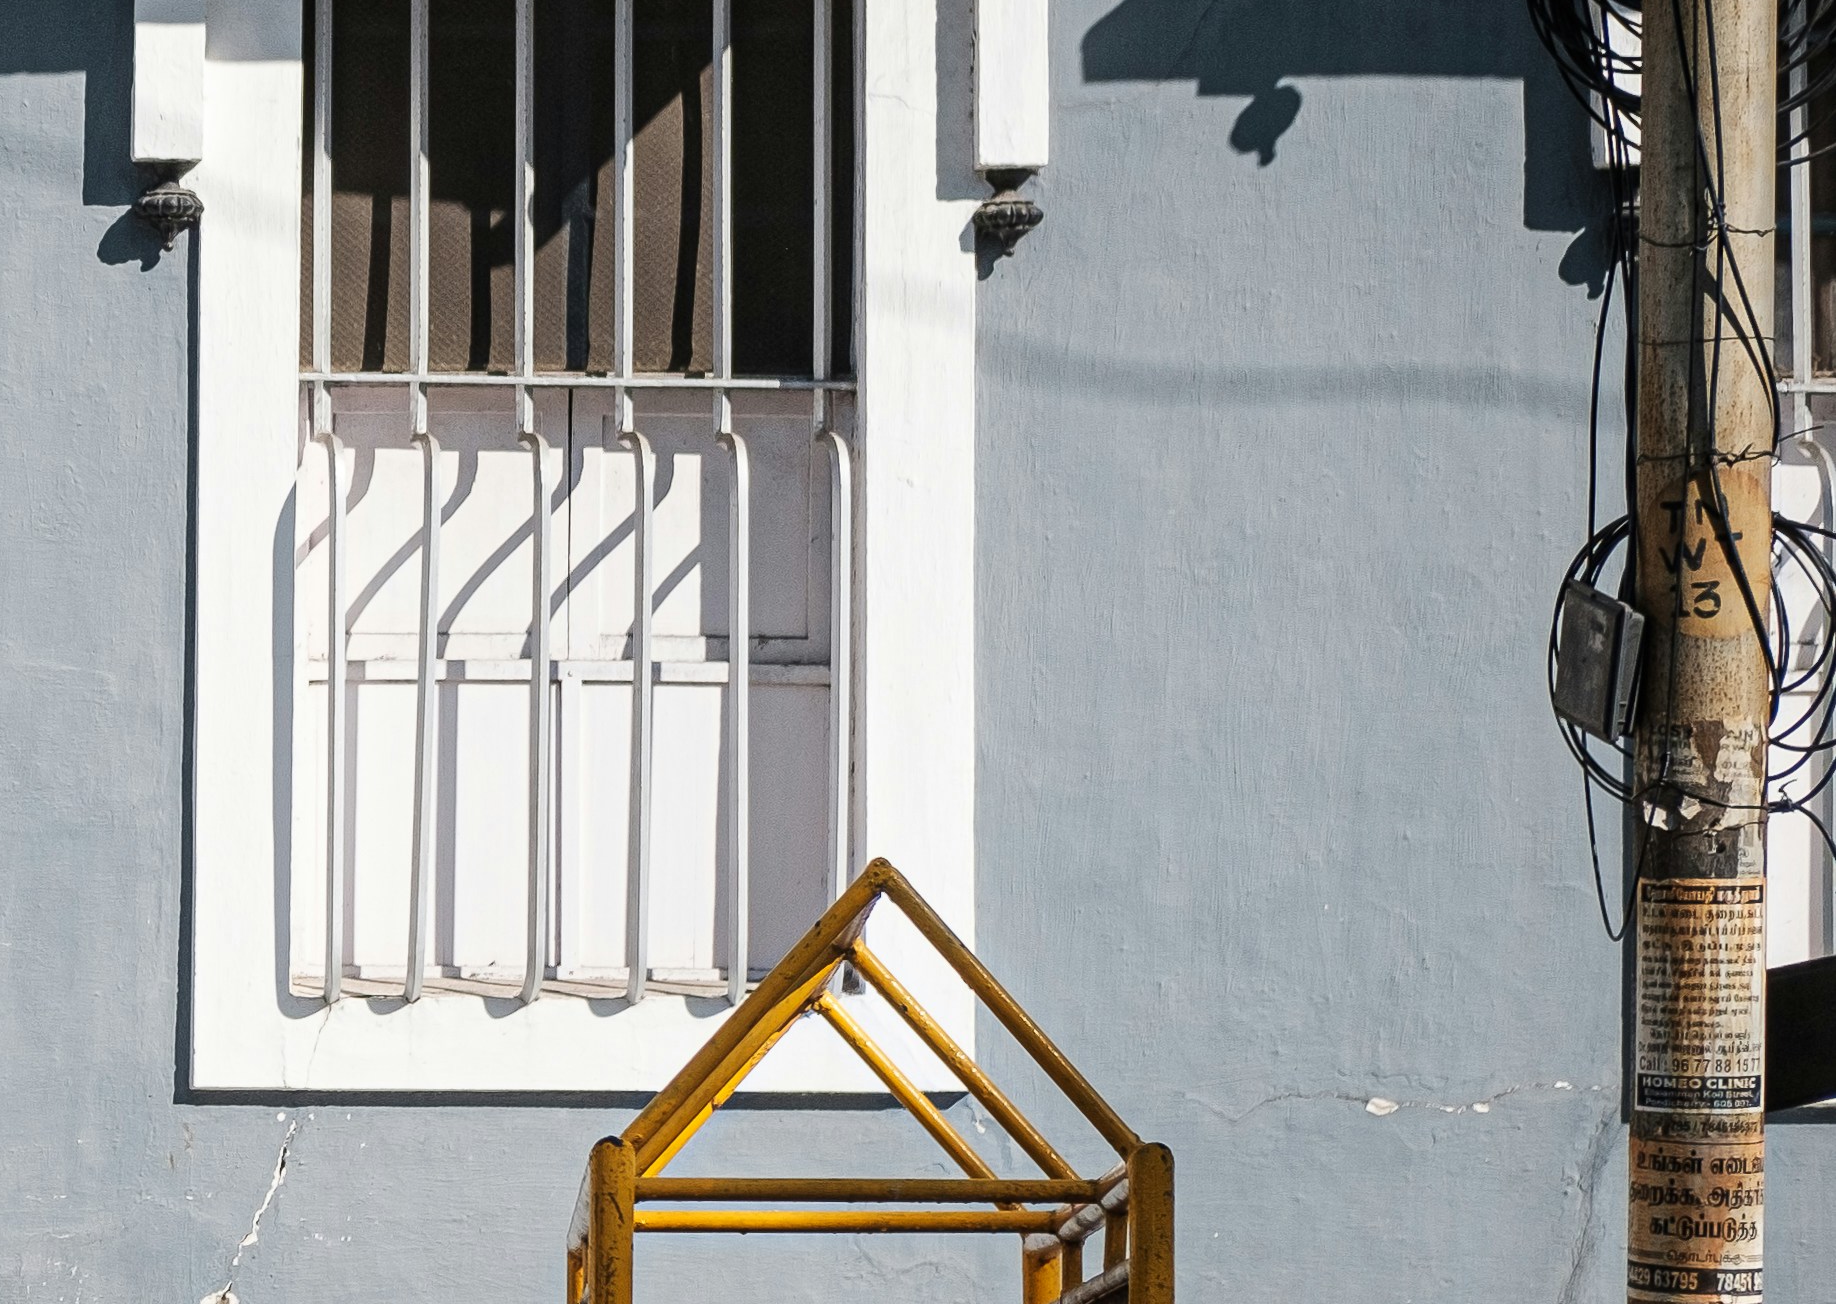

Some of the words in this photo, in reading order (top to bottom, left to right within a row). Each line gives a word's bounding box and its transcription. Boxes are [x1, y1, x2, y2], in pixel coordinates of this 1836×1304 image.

[1642, 1076, 1702, 1089] HOMEO
[1706, 1077, 1757, 1089] CLINIC
[1653, 1269, 1699, 1291] 63795
